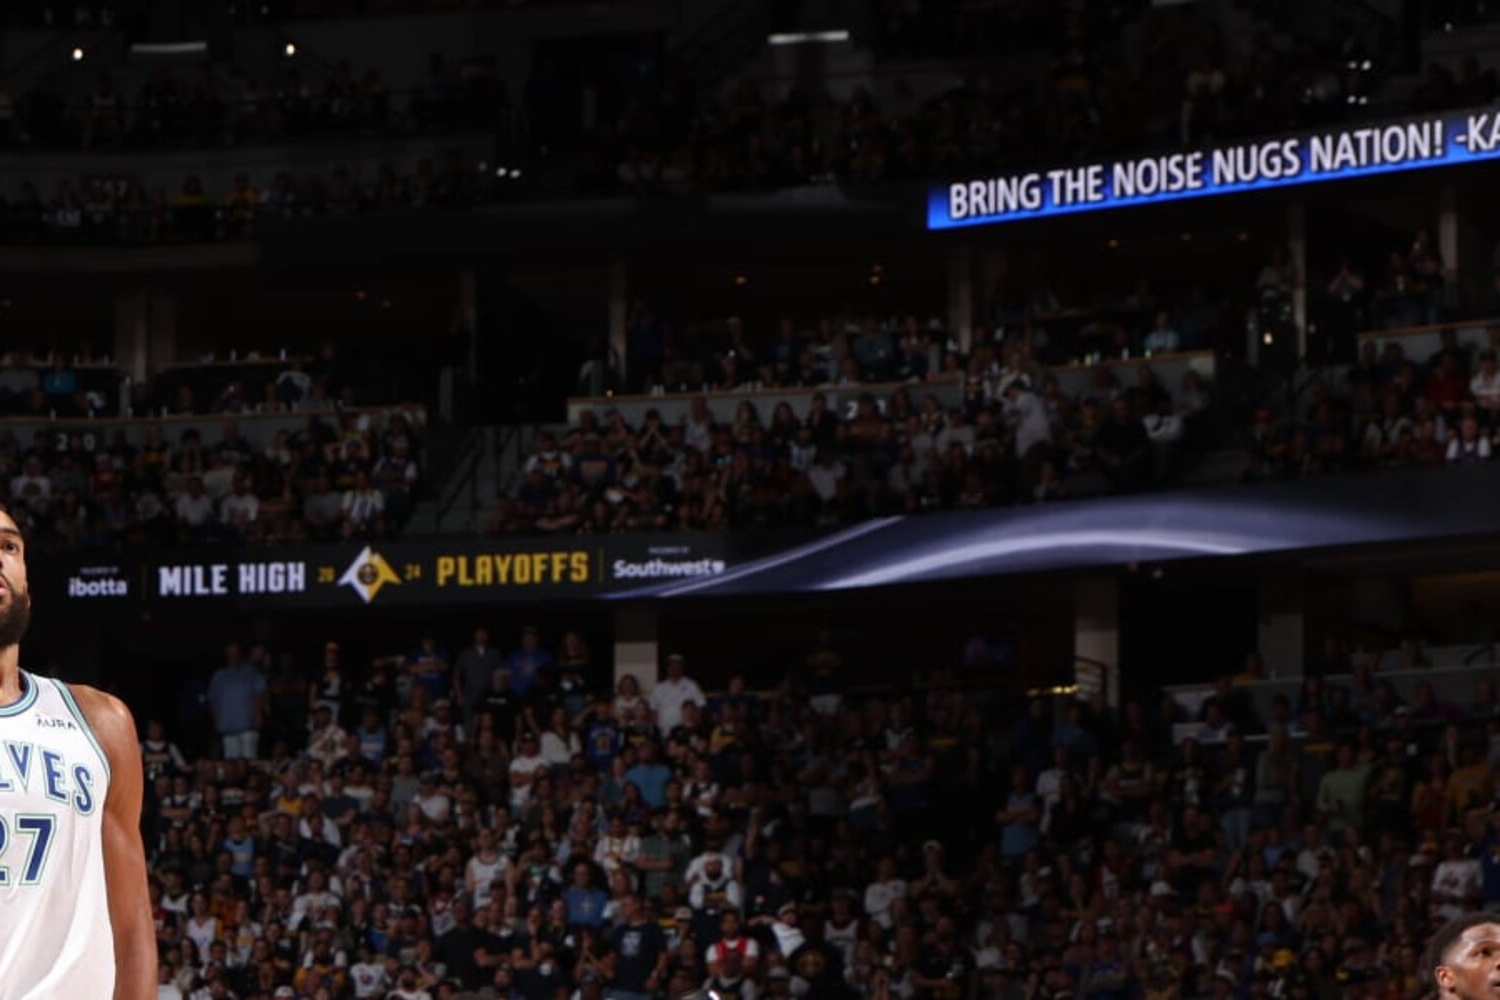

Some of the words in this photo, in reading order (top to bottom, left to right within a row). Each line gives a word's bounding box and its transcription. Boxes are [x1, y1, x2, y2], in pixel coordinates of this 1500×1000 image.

[950, 173, 1041, 219] BRING
[1048, 165, 1104, 206] THE
[1112, 152, 1202, 198] NOISE
[1212, 139, 1300, 185] NUGS
[1309, 120, 1443, 173] NATION!
[158, 564, 229, 596] MILE
[238, 561, 306, 594] HIGH
[436, 551, 589, 587] PLAYOFFS
[612, 557, 711, 579] Southwest
[68, 576, 129, 598] ibotta
